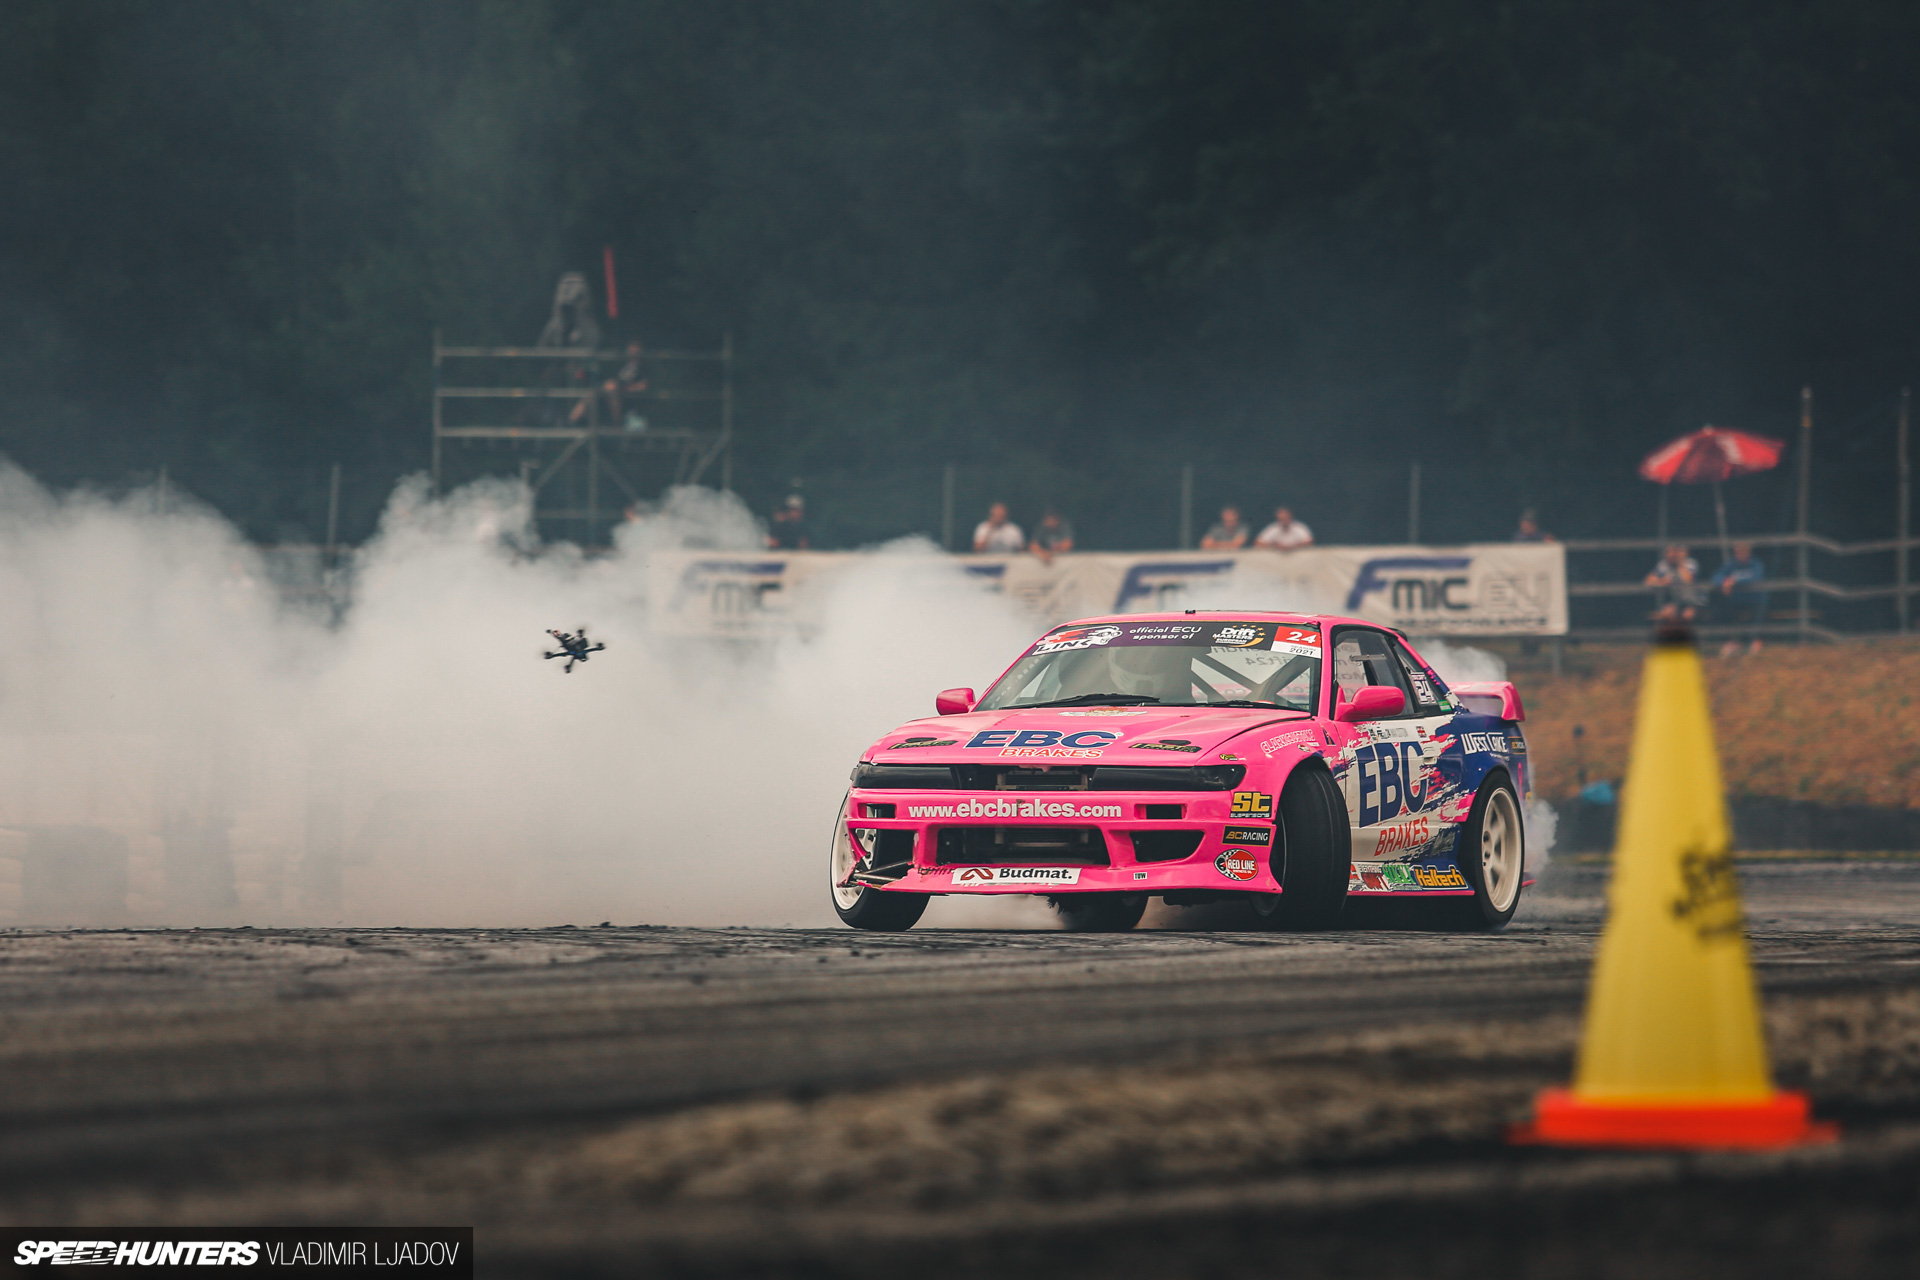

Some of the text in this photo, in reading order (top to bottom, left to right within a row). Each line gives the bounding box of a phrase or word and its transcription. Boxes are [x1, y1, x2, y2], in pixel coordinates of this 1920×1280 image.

[1171, 626, 1202, 634] ECU
[1221, 627, 1256, 636] Drift
[1286, 631, 1318, 644] 24
[1289, 648, 1314, 656] 2021
[964, 730, 1118, 749] EBC
[999, 748, 1103, 758] BRAKES
[1355, 741, 1428, 828] EBC
[908, 799, 1122, 818] www.ebcbrakes.com
[1374, 816, 1429, 857] BRAKES
[1227, 859, 1256, 871] RED LINE
[999, 868, 1072, 879] Budmat.
[1414, 867, 1466, 887] Haltech
